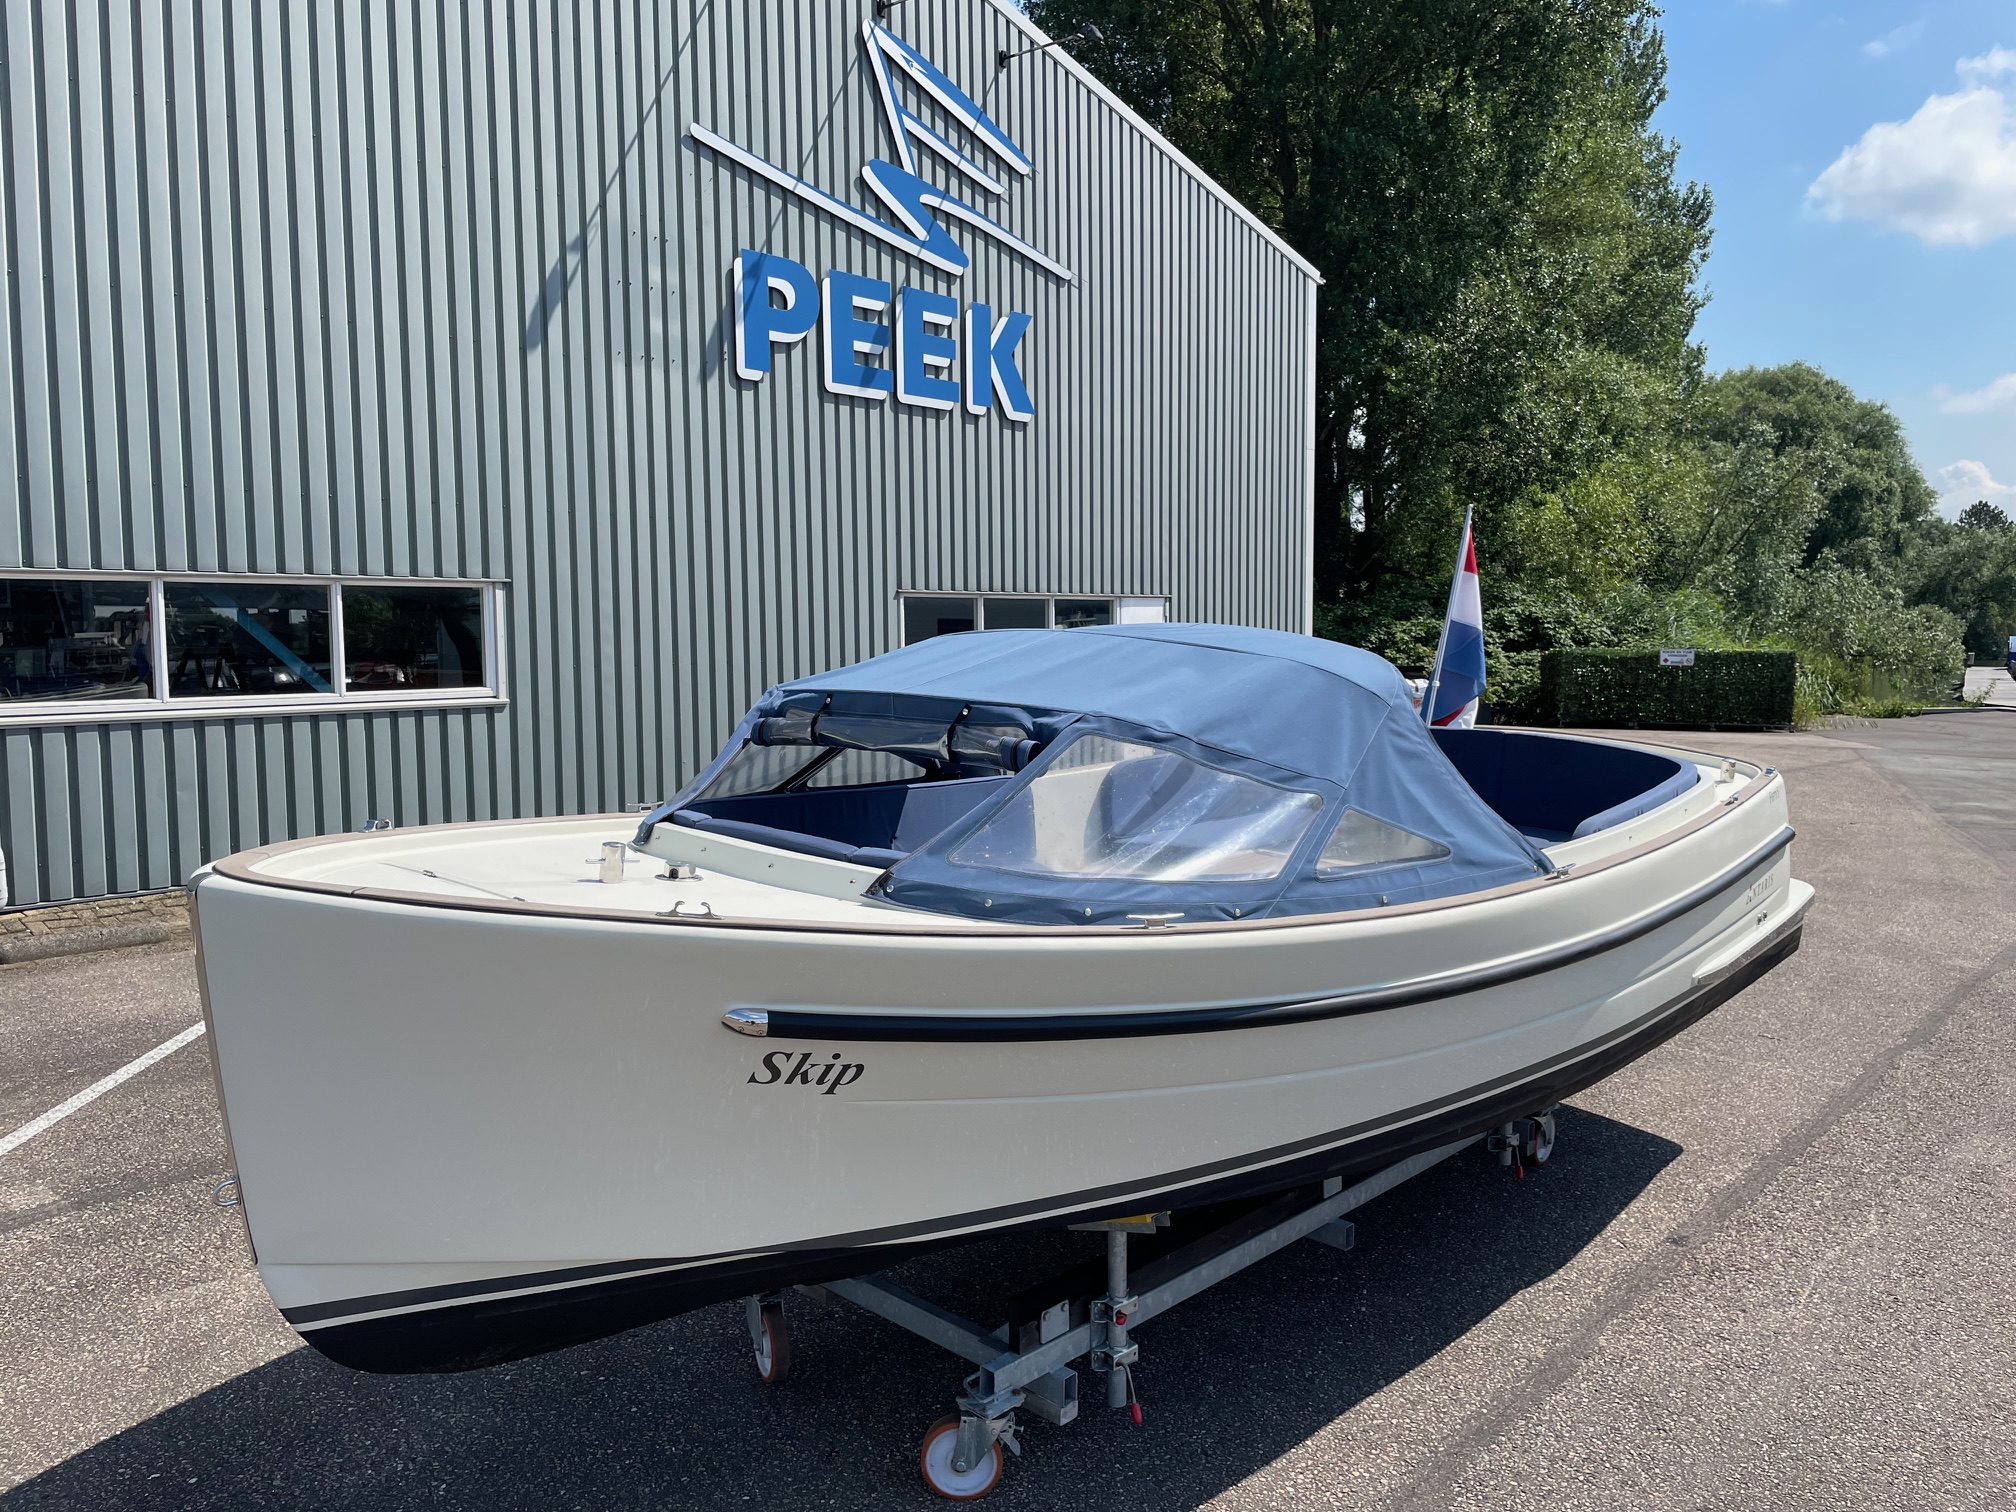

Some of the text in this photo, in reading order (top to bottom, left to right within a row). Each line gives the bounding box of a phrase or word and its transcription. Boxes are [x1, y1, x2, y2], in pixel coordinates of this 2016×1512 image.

[734, 248, 1036, 423] PEEK
[1745, 873, 1774, 906] ANTARIS
[747, 1051, 865, 1095] Skip
